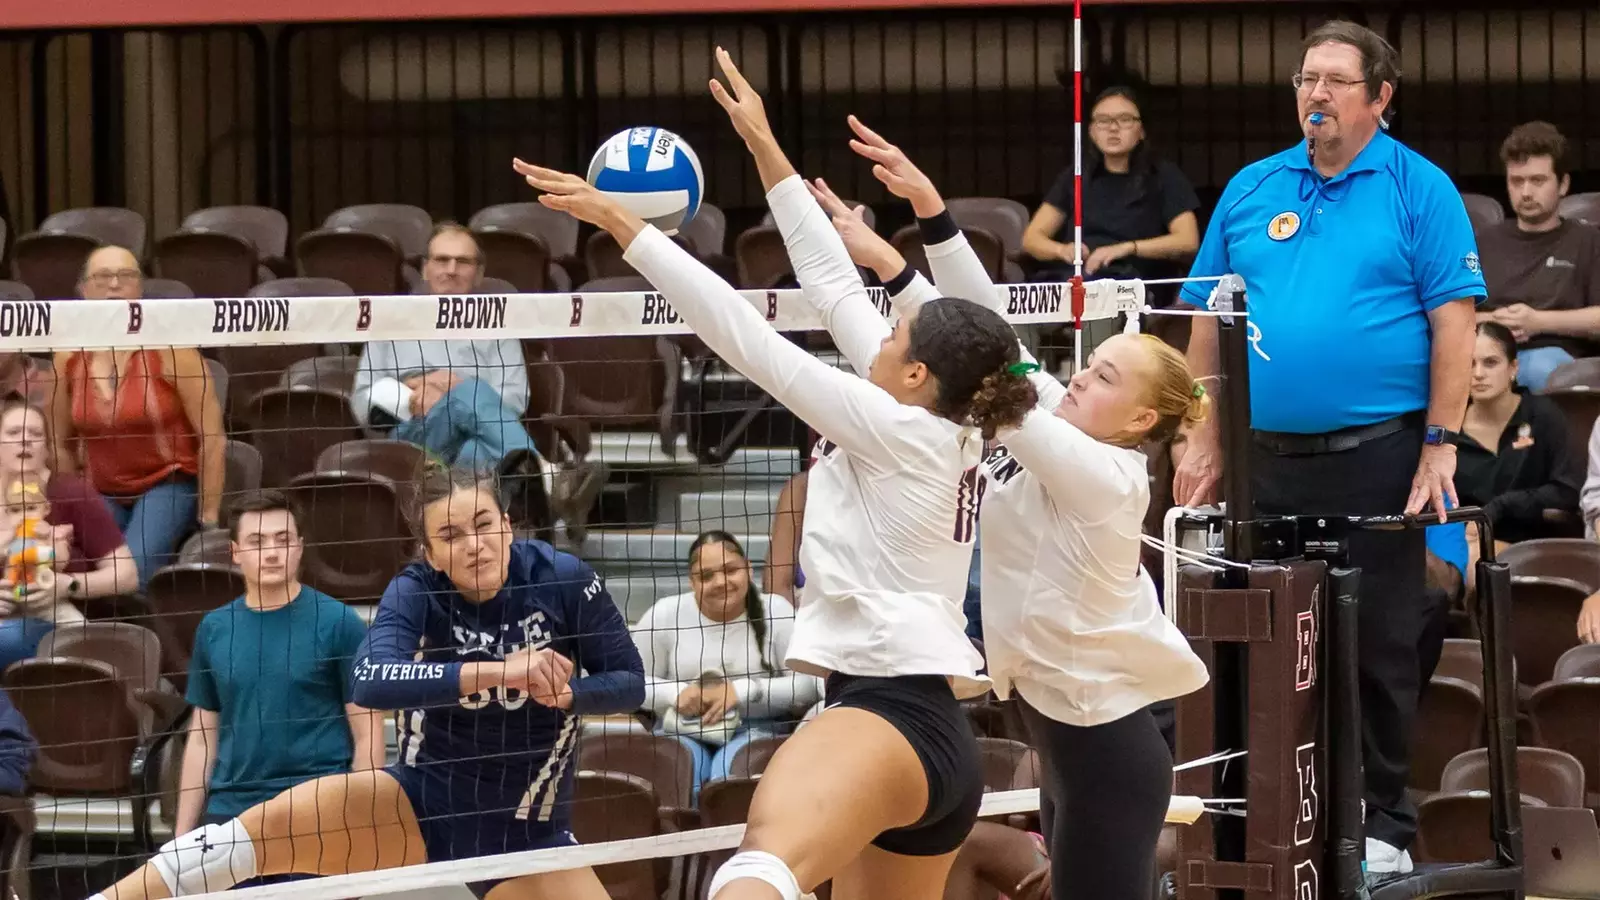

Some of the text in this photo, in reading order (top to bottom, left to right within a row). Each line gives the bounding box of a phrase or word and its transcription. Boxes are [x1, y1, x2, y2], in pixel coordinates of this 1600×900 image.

[127, 300, 143, 334] B
[212, 299, 290, 333] BROWN
[355, 297, 373, 332] B
[436, 296, 507, 330] BROWN
[569, 294, 584, 328] B
[641, 293, 685, 325] BRO
[766, 291, 778, 322] B
[1007, 284, 1062, 315] BROWN
[382, 663, 445, 681] VERITAS
